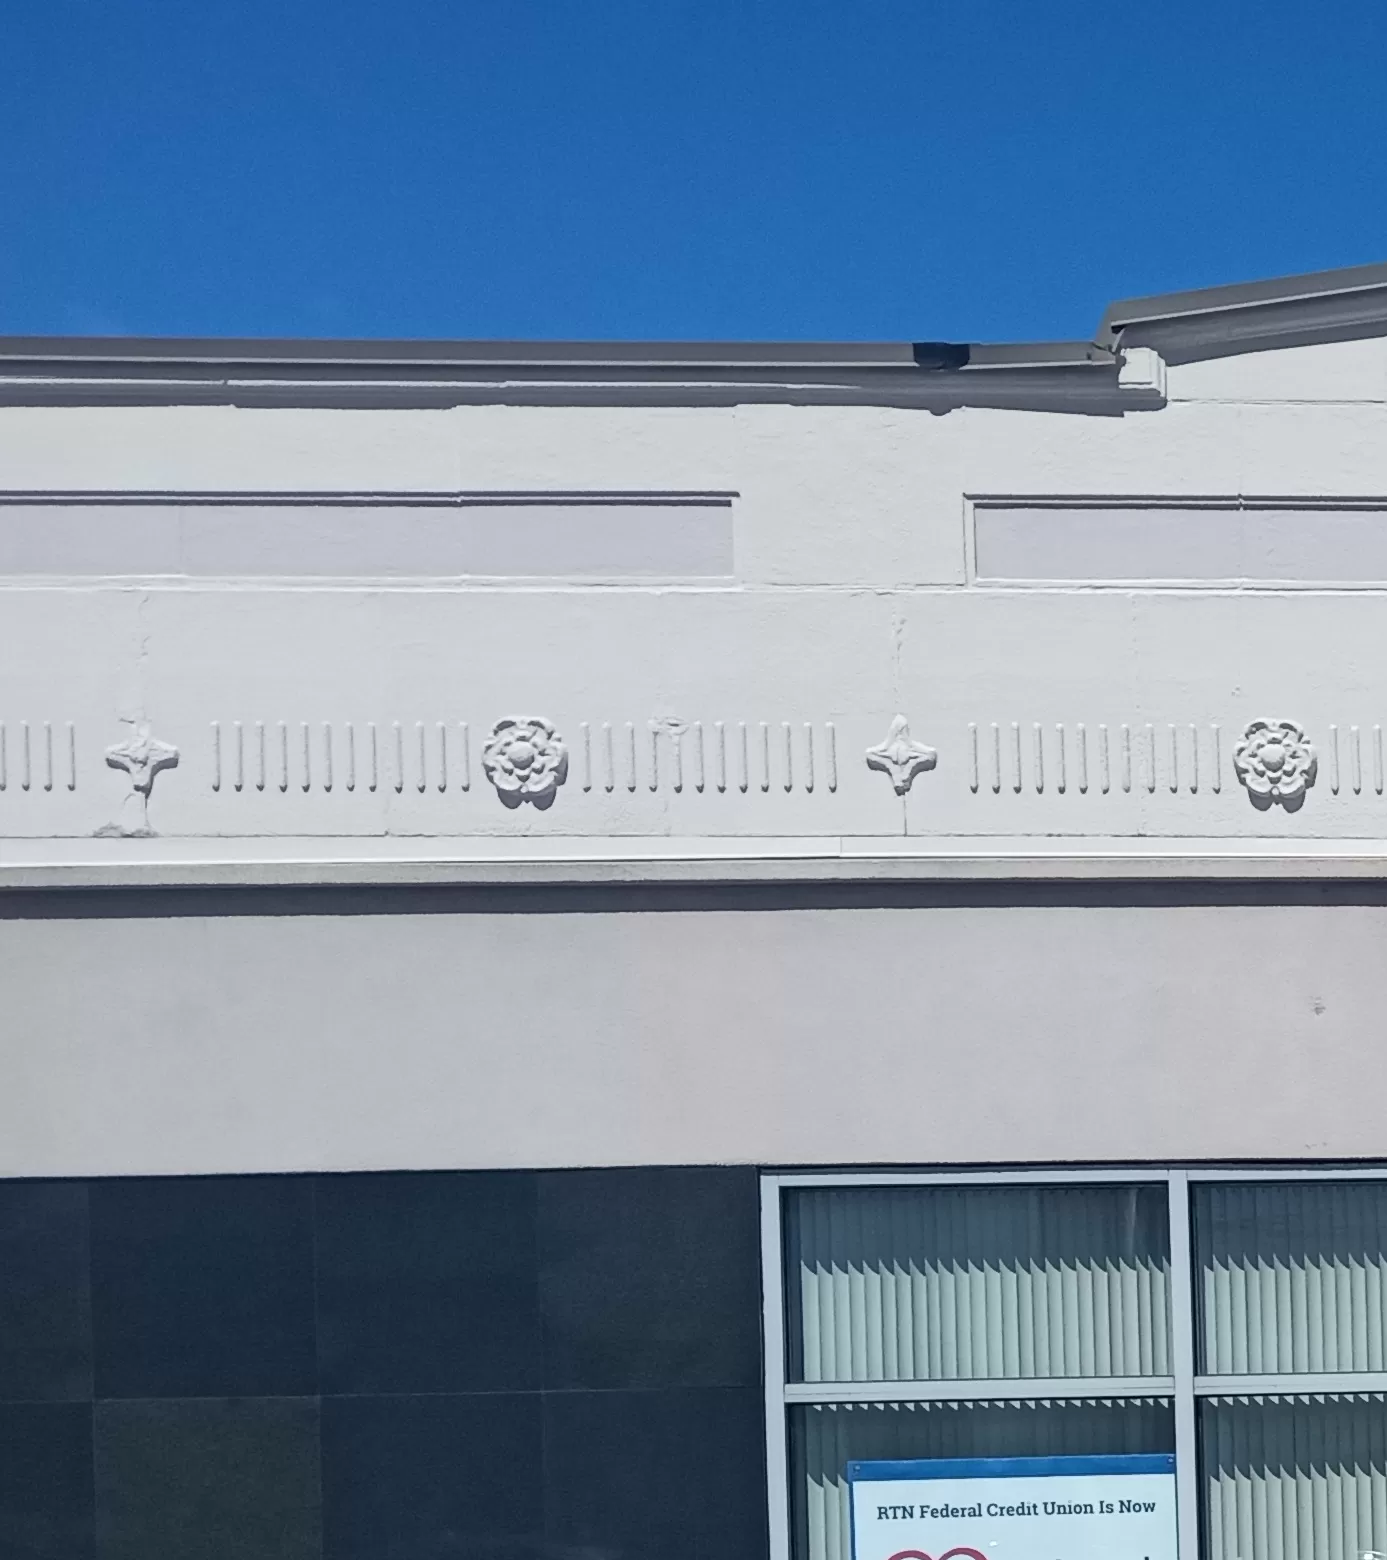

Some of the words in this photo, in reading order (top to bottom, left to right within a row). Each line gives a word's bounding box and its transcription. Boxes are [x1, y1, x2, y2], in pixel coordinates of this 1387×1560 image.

[877, 1505, 914, 1520] RTN
[919, 1503, 983, 1519] Federal
[987, 1501, 1039, 1517] Credit
[1043, 1500, 1094, 1515] Union
[1099, 1500, 1115, 1514] Is
[1119, 1500, 1156, 1514] Now
